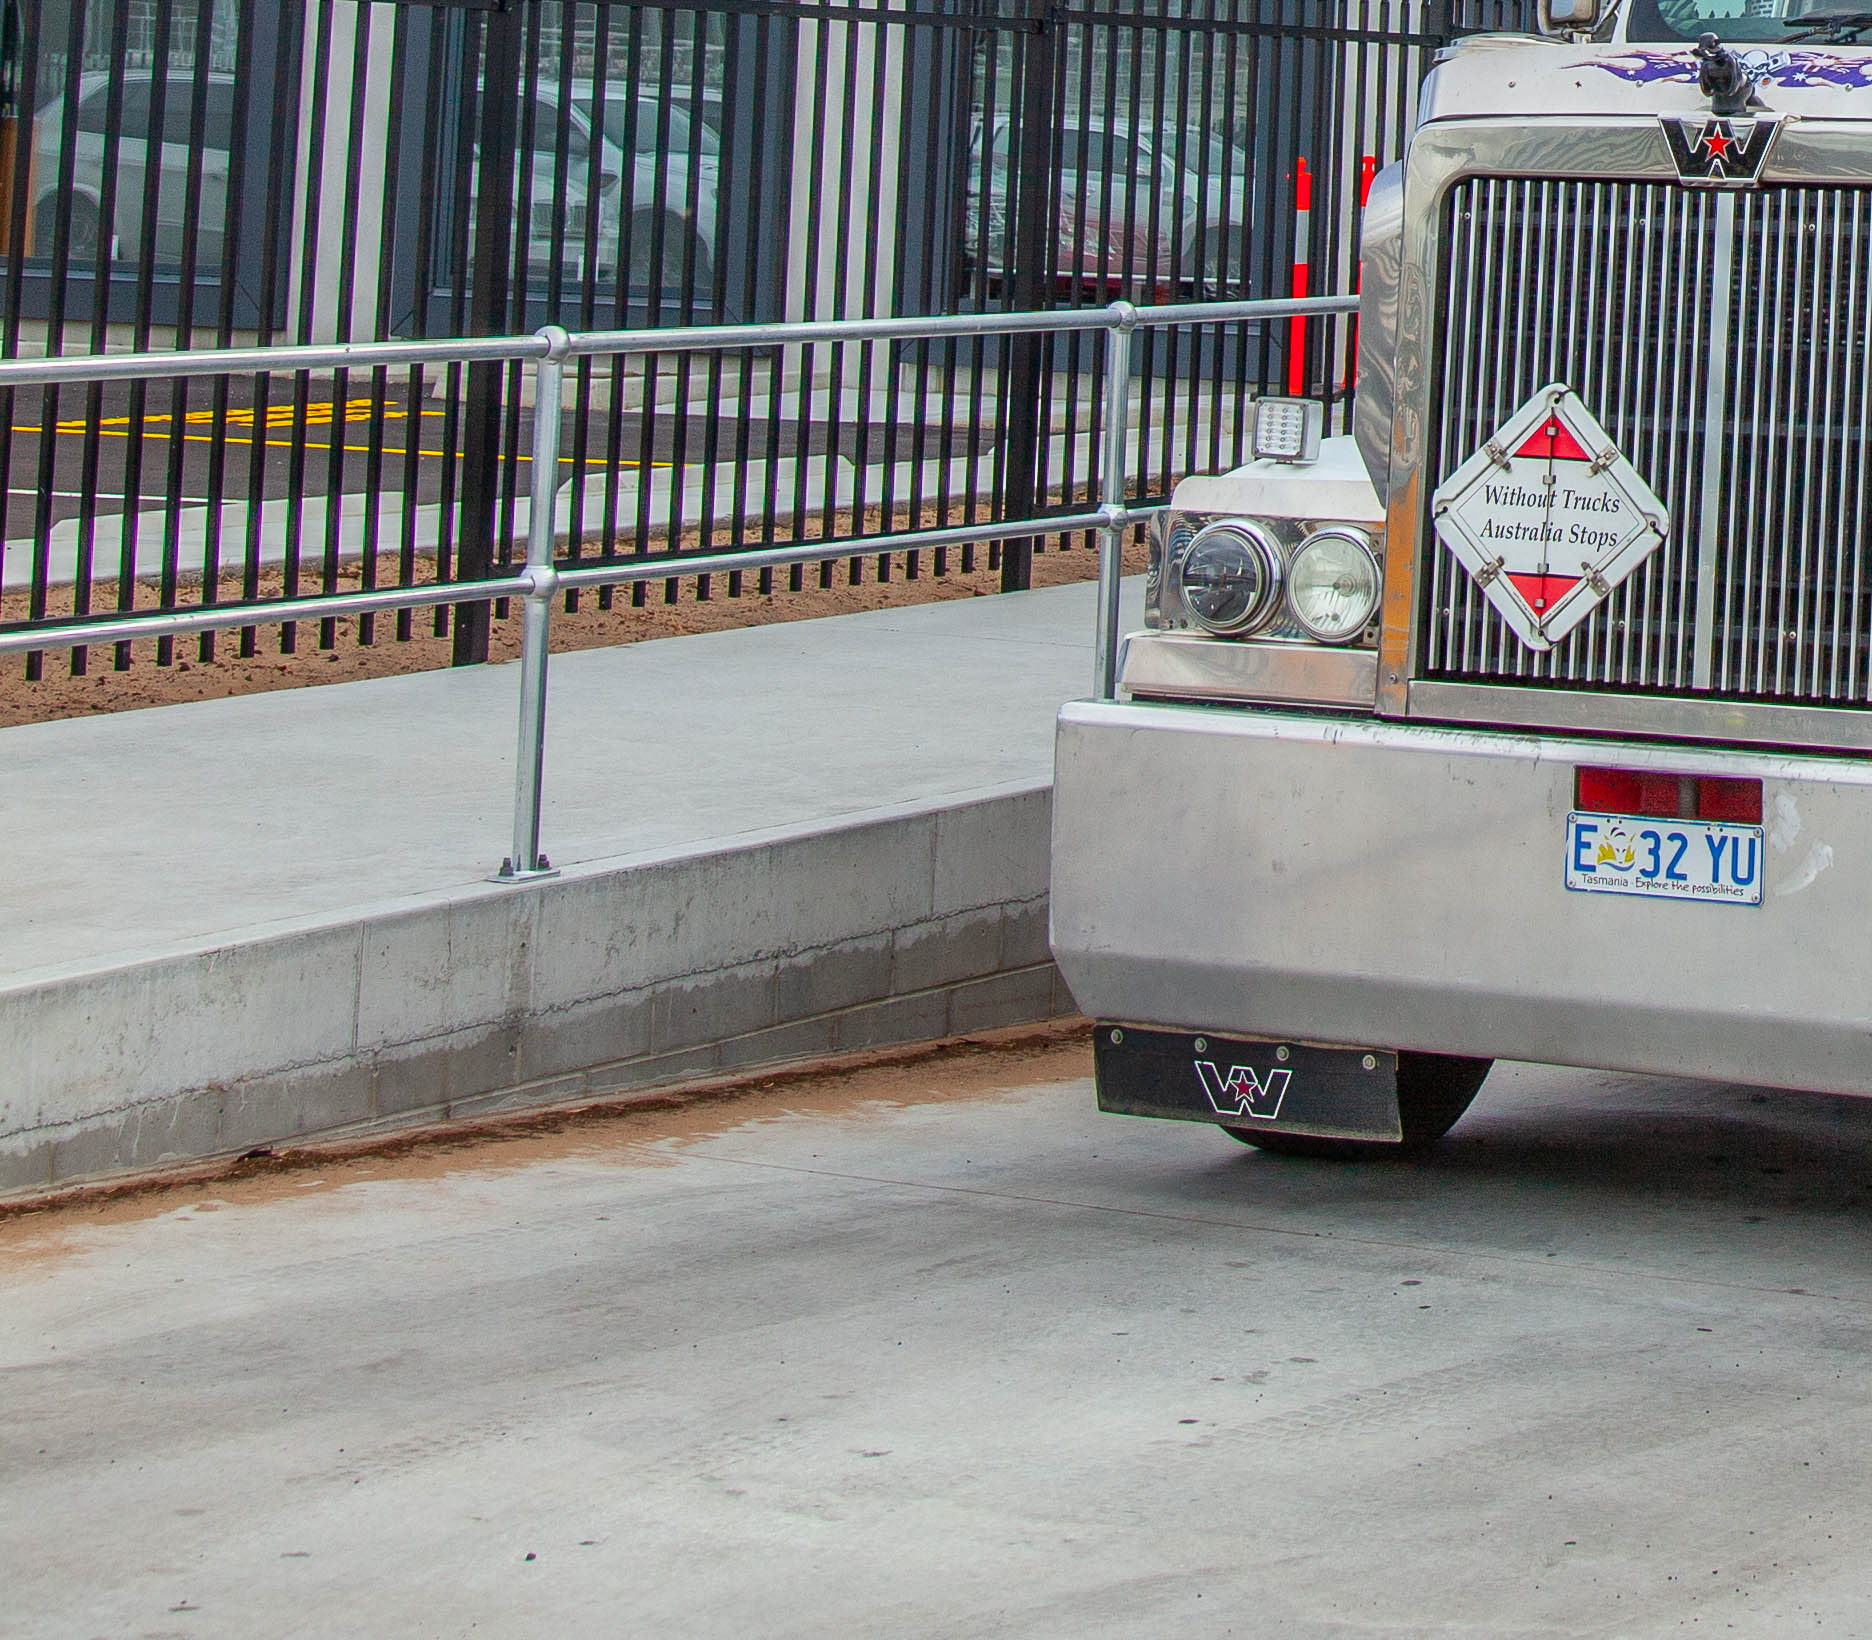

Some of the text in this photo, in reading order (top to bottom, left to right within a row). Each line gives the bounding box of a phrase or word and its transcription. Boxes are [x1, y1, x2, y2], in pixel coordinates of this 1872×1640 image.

[1485, 484, 1620, 513] Without Trucks
[1480, 518, 1618, 553] Australia Stops
[1582, 873, 1745, 897] Tasmania Explore the possibilities
